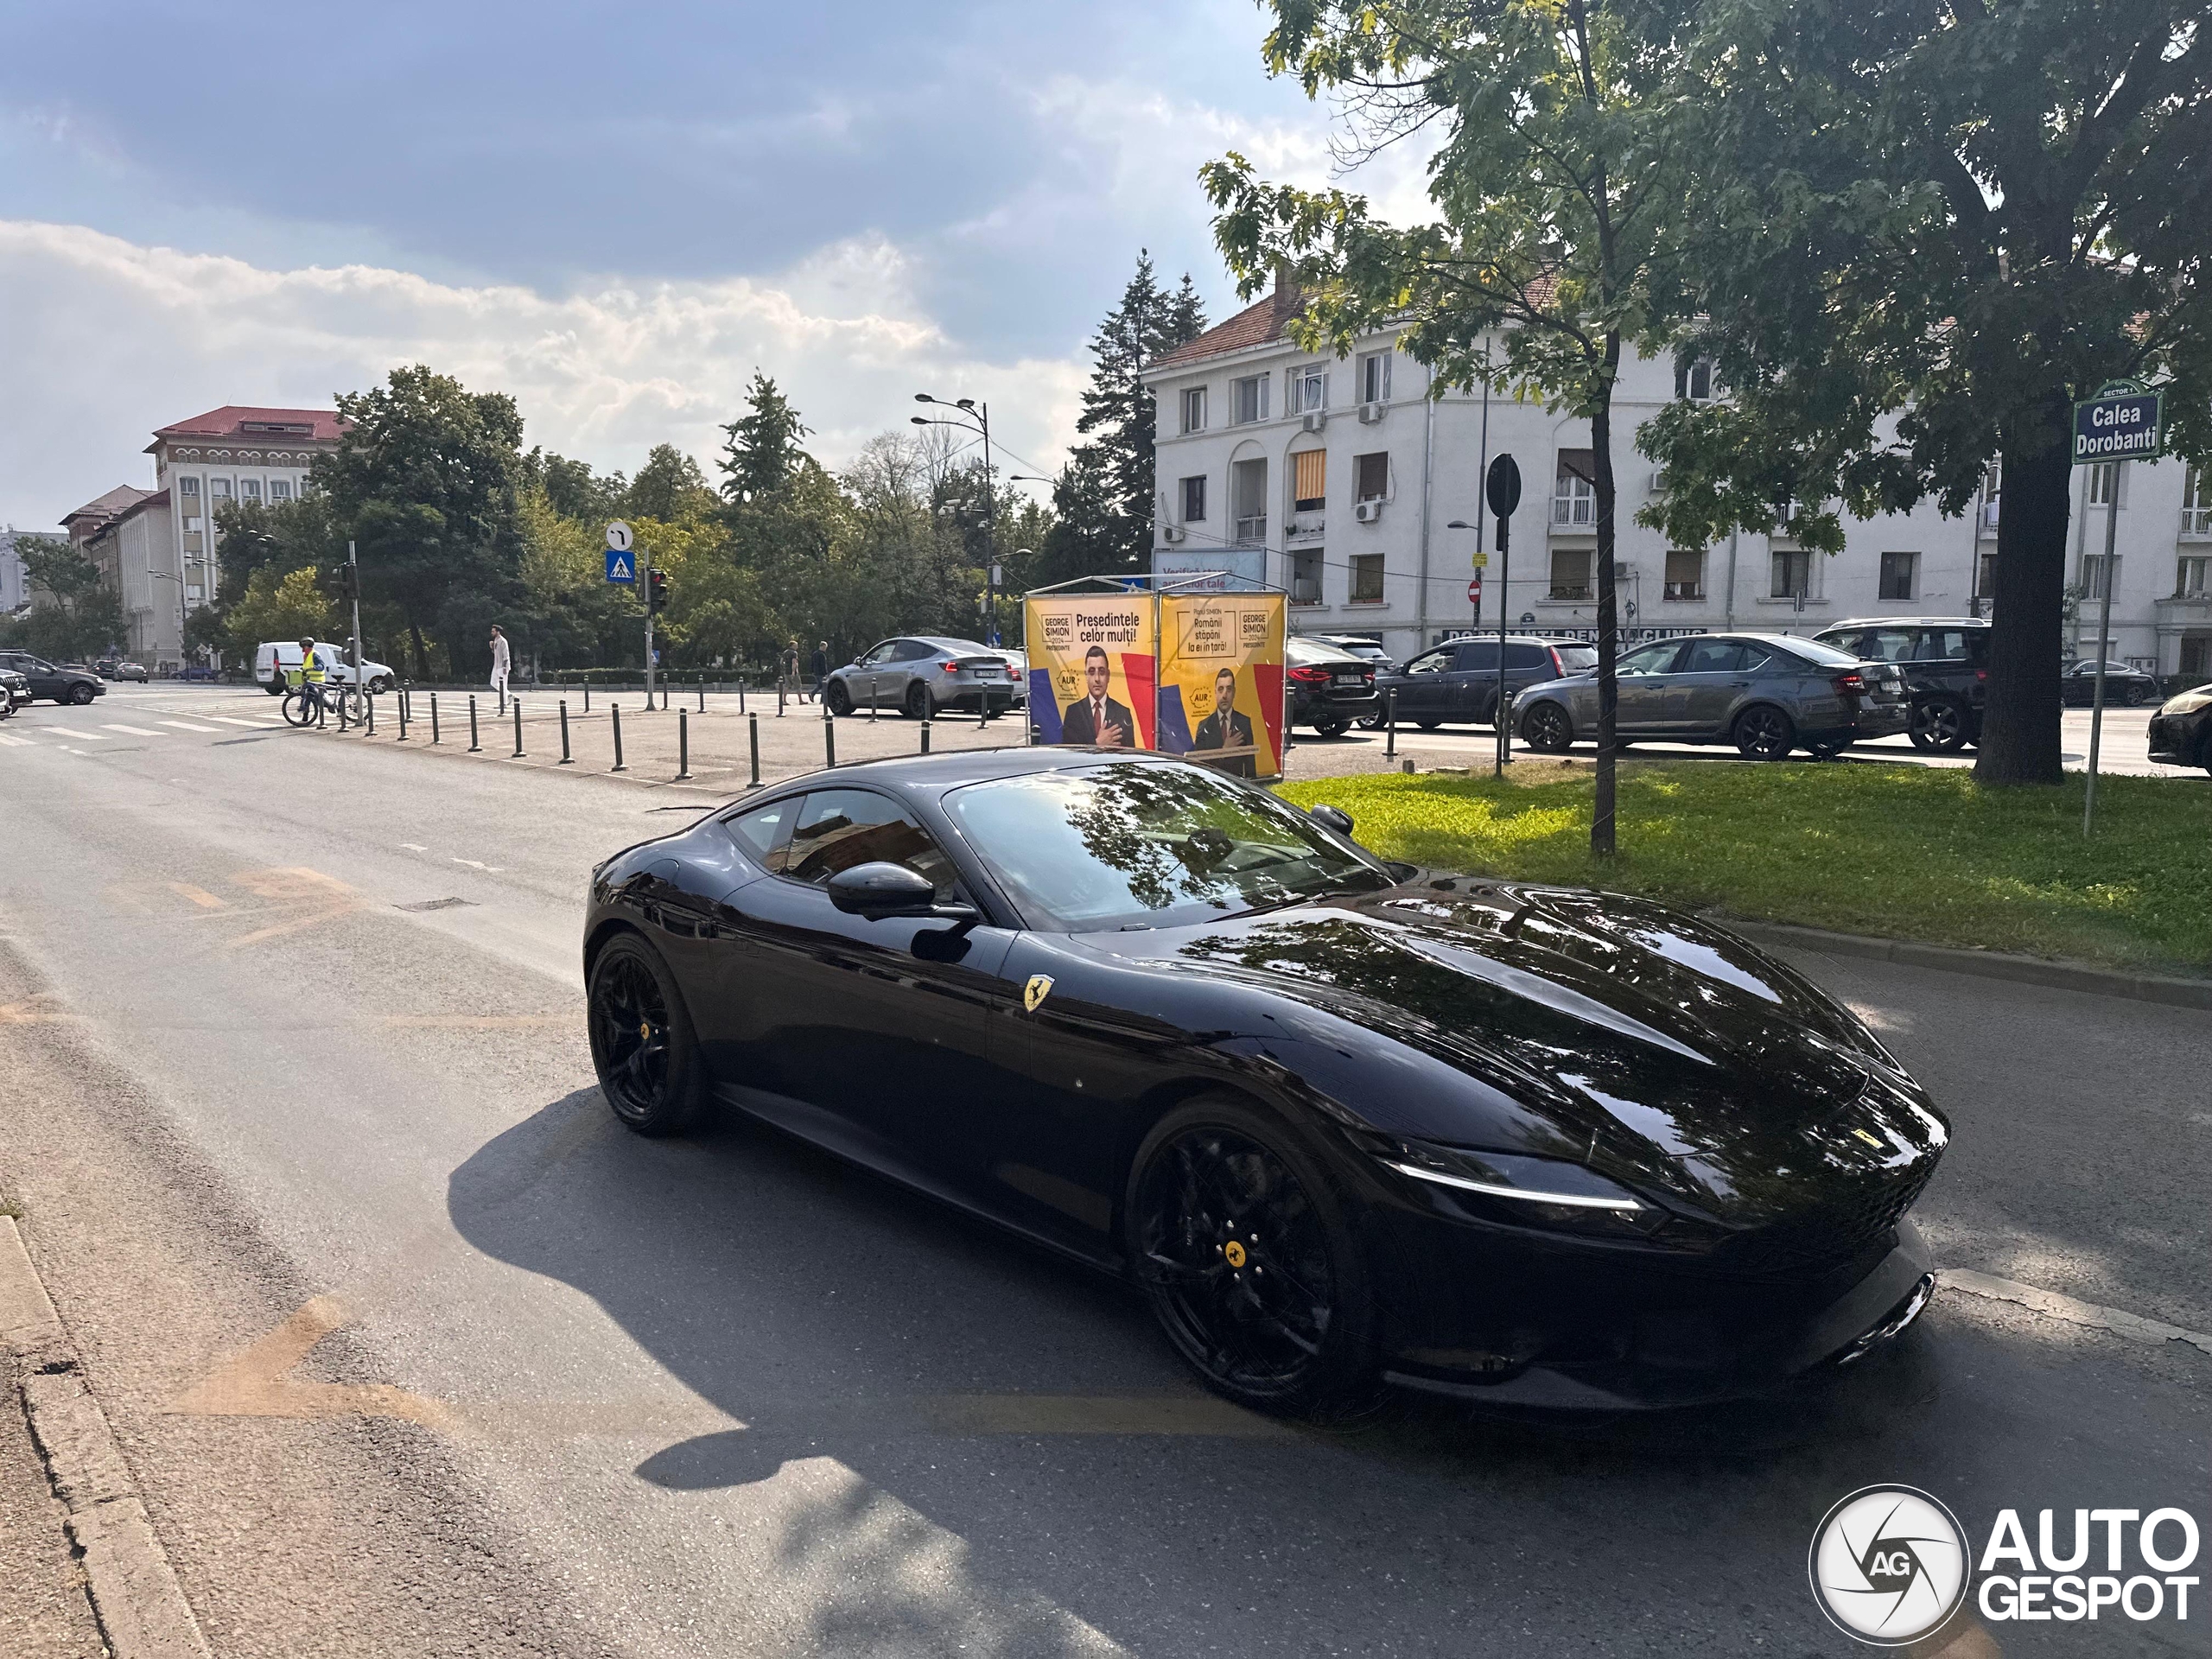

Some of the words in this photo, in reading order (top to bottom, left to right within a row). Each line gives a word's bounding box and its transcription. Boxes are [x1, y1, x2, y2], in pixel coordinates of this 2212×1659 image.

[2103, 388, 2128, 397] SECTOR
[2092, 404, 2141, 427] Calea
[2076, 426, 2157, 454] Dorobanți
[1207, 579, 1225, 588] tale
[1046, 618, 1069, 626] GEORGE
[1077, 612, 1140, 632] Președintele
[1194, 617, 1223, 627] Românii
[1243, 614, 1266, 623] GEORGE
[1046, 627, 1070, 636] SIMION
[1243, 624, 1266, 633] SIMION
[1080, 628, 1105, 642] celor
